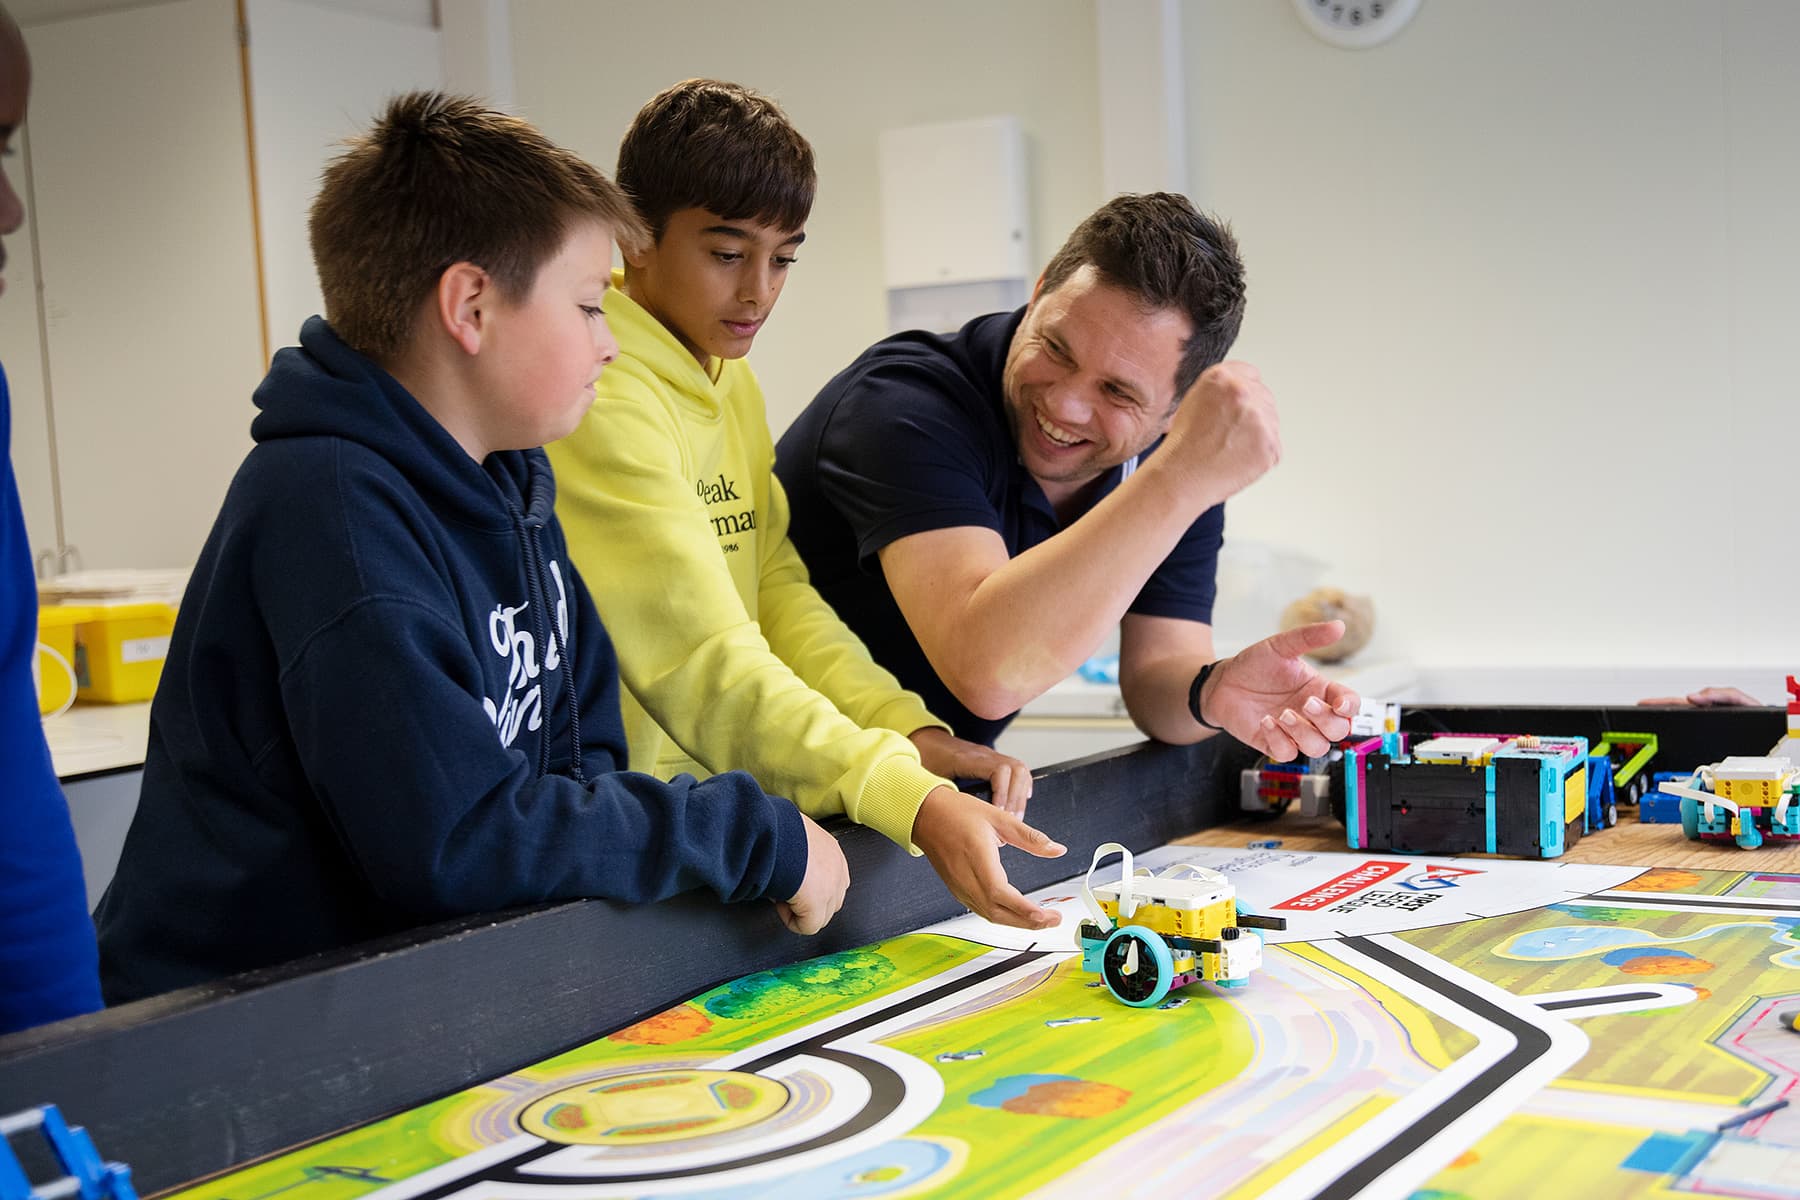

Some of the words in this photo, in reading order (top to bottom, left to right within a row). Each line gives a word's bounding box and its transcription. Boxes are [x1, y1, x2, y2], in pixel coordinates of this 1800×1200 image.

[722, 543, 739, 554] 986
[1289, 865, 1391, 908] CHALLENGE
[1371, 890, 1420, 908] LEGO
[1396, 893, 1444, 912] FIRST
